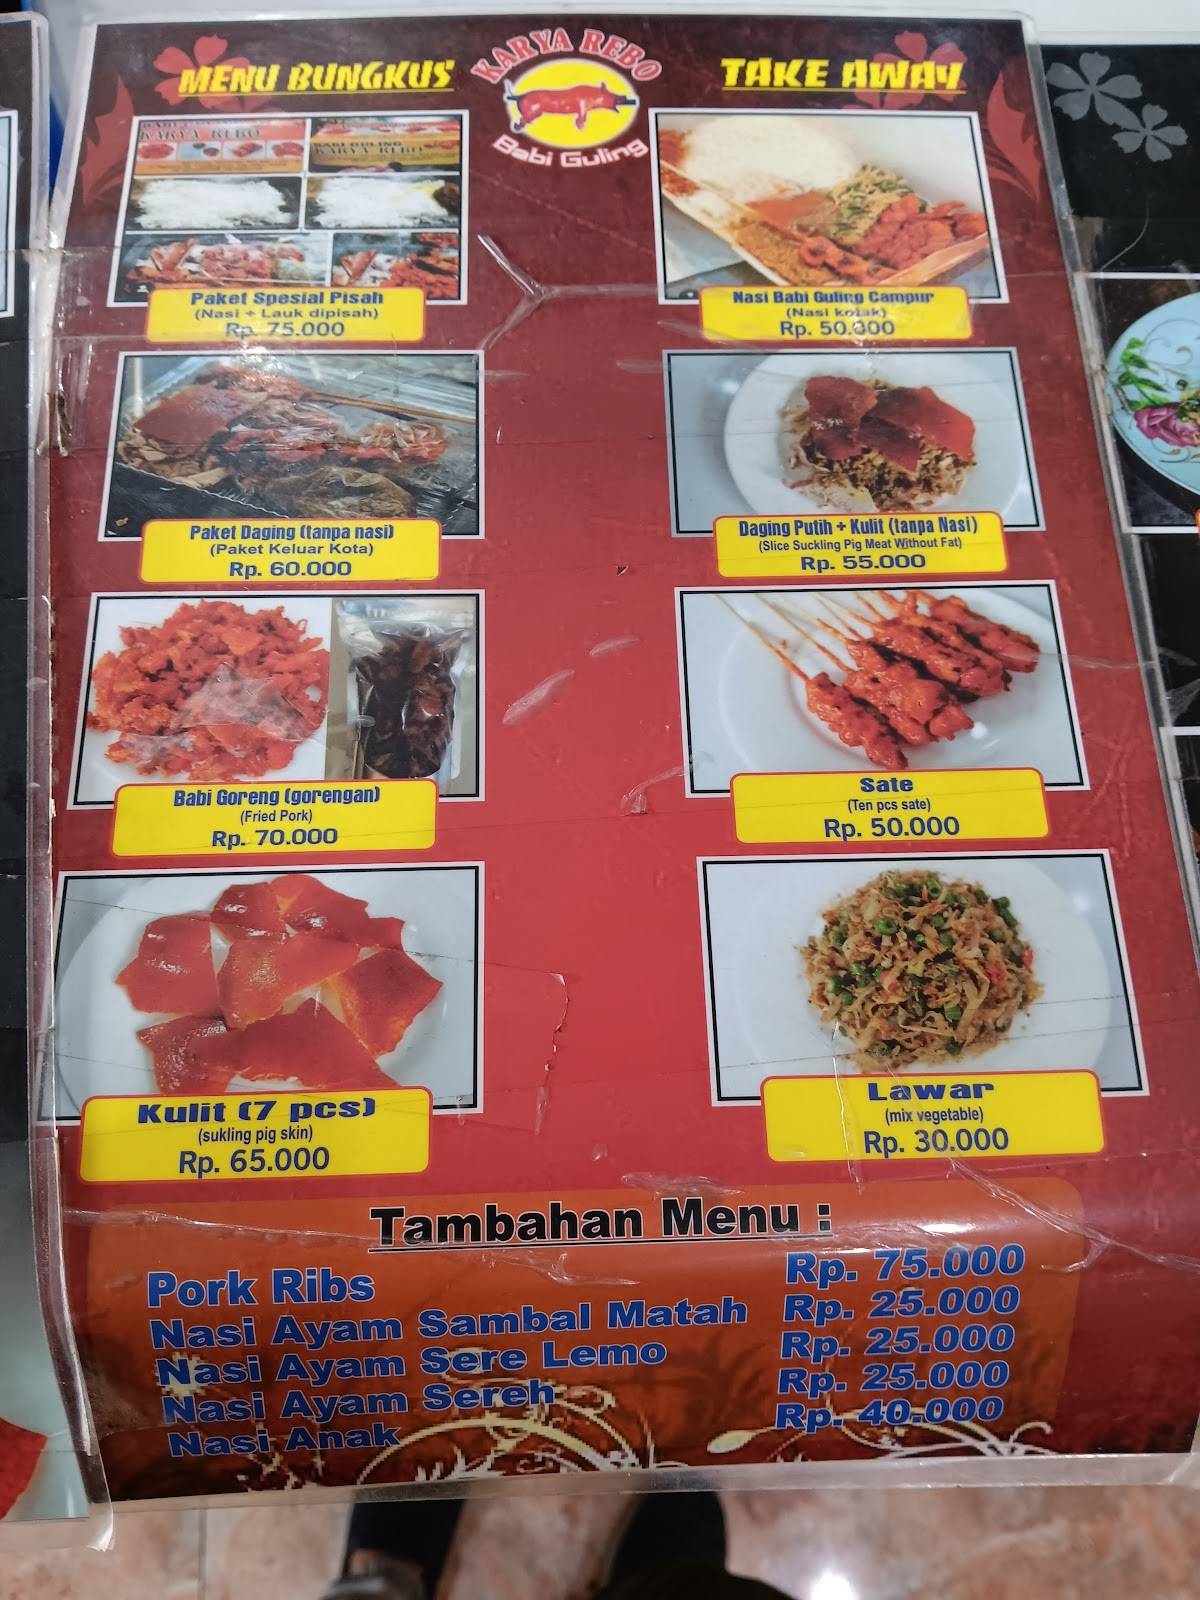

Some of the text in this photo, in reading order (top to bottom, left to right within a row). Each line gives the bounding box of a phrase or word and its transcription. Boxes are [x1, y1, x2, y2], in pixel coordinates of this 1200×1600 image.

[470, 27, 662, 84] KARYA REBO
[178, 60, 455, 94] MENU BUNGKUS
[721, 57, 967, 90] TAKE AWAY
[492, 134, 649, 167] Babi Guling
[191, 292, 384, 305] Paket Spesial Pisah
[733, 291, 934, 304] Nasi Babi Guling Campur
[195, 308, 379, 320] (Nasi + Lauk dipisah)
[786, 308, 829, 318] (Nasi
[267, 322, 345, 336] 75.000
[779, 321, 895, 338] Rp. 50.000
[190, 524, 394, 541] Paket Daging (tanpa nasi)
[739, 516, 978, 537] Daging Putih + Kulit (tanpa Nasi)
[210, 543, 374, 557] (Paket Keluar Kota)
[759, 537, 962, 553] (Slice Suckling Pig Meat Without Fat)
[229, 562, 352, 579] Rp. 60.000
[800, 554, 926, 573] Rp. 55.000
[860, 777, 914, 792] Sate
[174, 786, 380, 806] Babi Goreng (gorengan)
[848, 798, 931, 813] (Ten pcs sate)
[240, 809, 313, 826] (Fried Pork)
[212, 828, 338, 850] Rp. 70.000
[824, 817, 960, 841] Rp. 50.000
[868, 1083, 995, 1101] Lawar
[138, 1097, 375, 1124] Kulit (7 pcs)
[885, 1106, 984, 1126] (mix vegetable)
[198, 1125, 313, 1146] (sukling pig skin)
[863, 1127, 1009, 1159] Rp. 30.000
[180, 1147, 330, 1179] Rp. 65.000
[369, 1196, 833, 1247] Tambahan Menu :
[785, 1243, 1025, 1290] Rp. 75.000
[148, 1266, 376, 1308] Pork Ribs
[783, 1285, 1021, 1327] Rp. 25.000
[150, 1296, 747, 1350] Nasi Ayam Sambal Matah
[781, 1323, 1015, 1364] Rp. 25.000
[156, 1341, 667, 1387] Nasi Ayam Sere Lemo
[778, 1360, 1009, 1399] Rp. 25.000
[162, 1378, 555, 1424] Nasi Ayam Sereh
[775, 1396, 1004, 1434] Rp. 40.000
[168, 1423, 401, 1458] Nasi Anak
